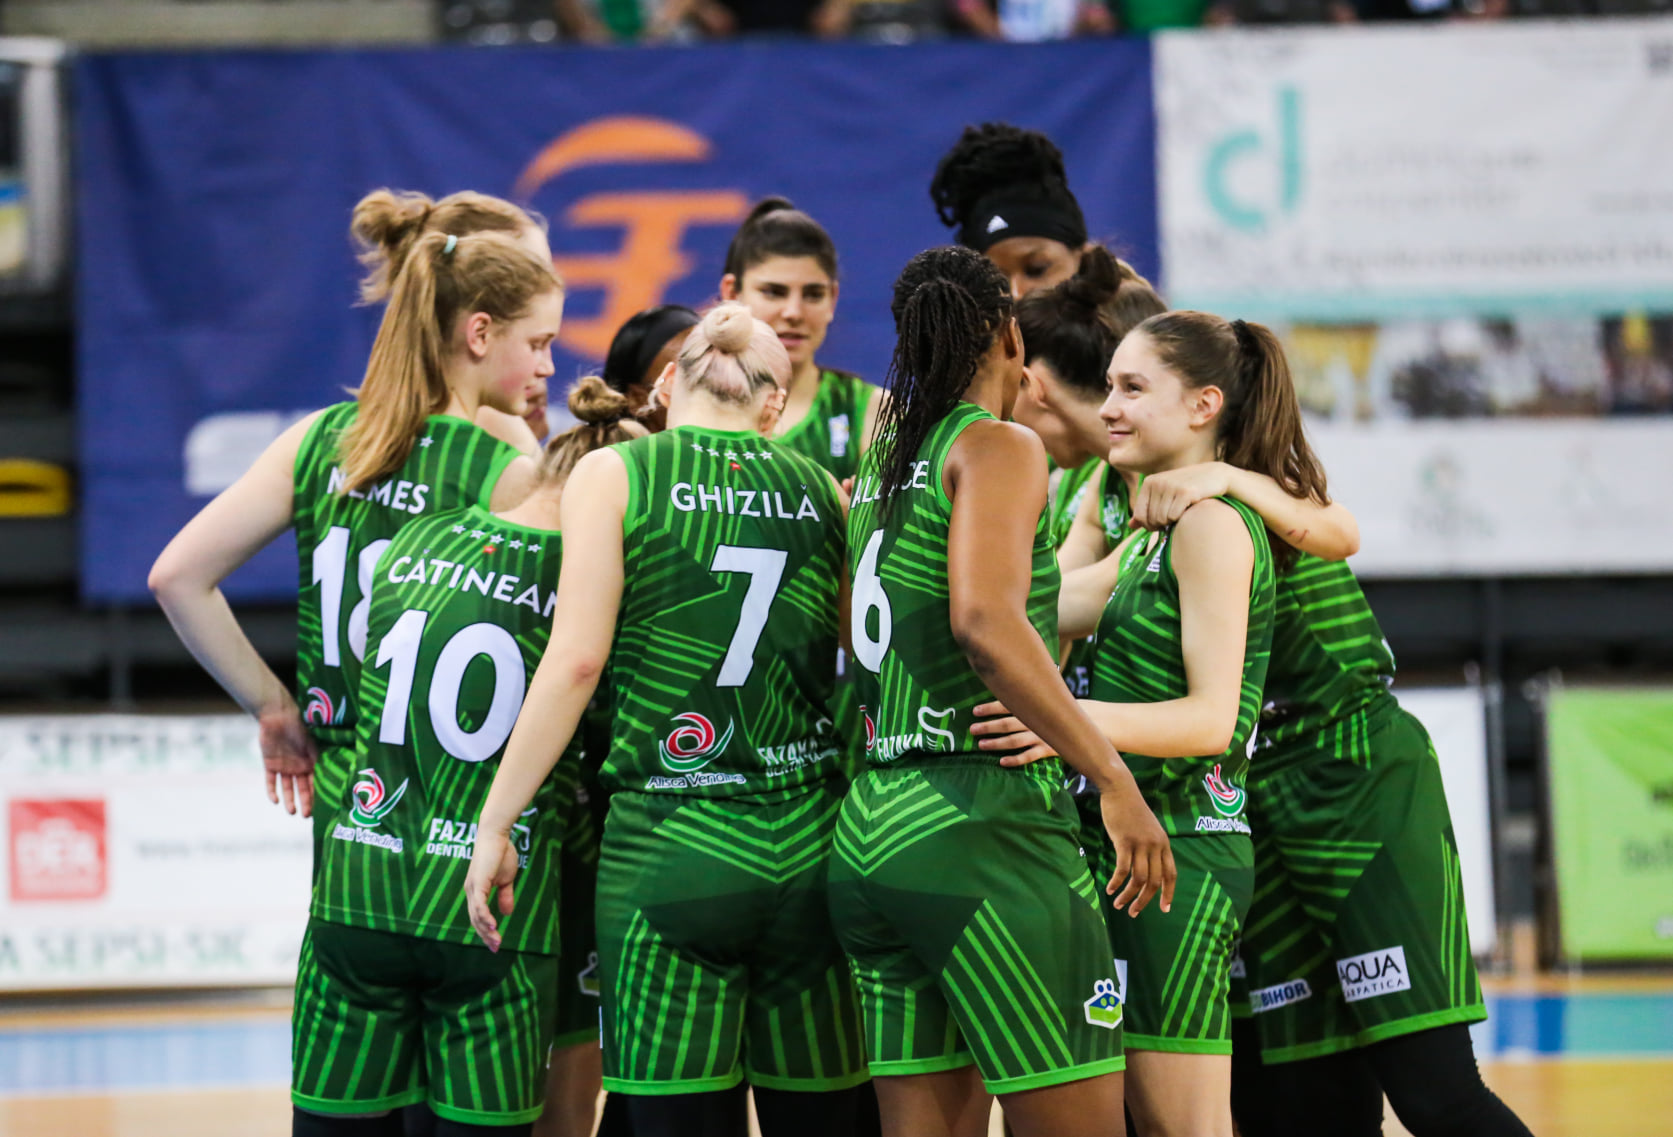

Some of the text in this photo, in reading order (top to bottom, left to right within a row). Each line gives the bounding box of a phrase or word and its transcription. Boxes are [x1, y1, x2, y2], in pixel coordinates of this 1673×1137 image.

[710, 544, 788, 687] 7
[851, 528, 893, 674] 6
[375, 609, 526, 762] 10
[428, 818, 478, 845] FAZA
